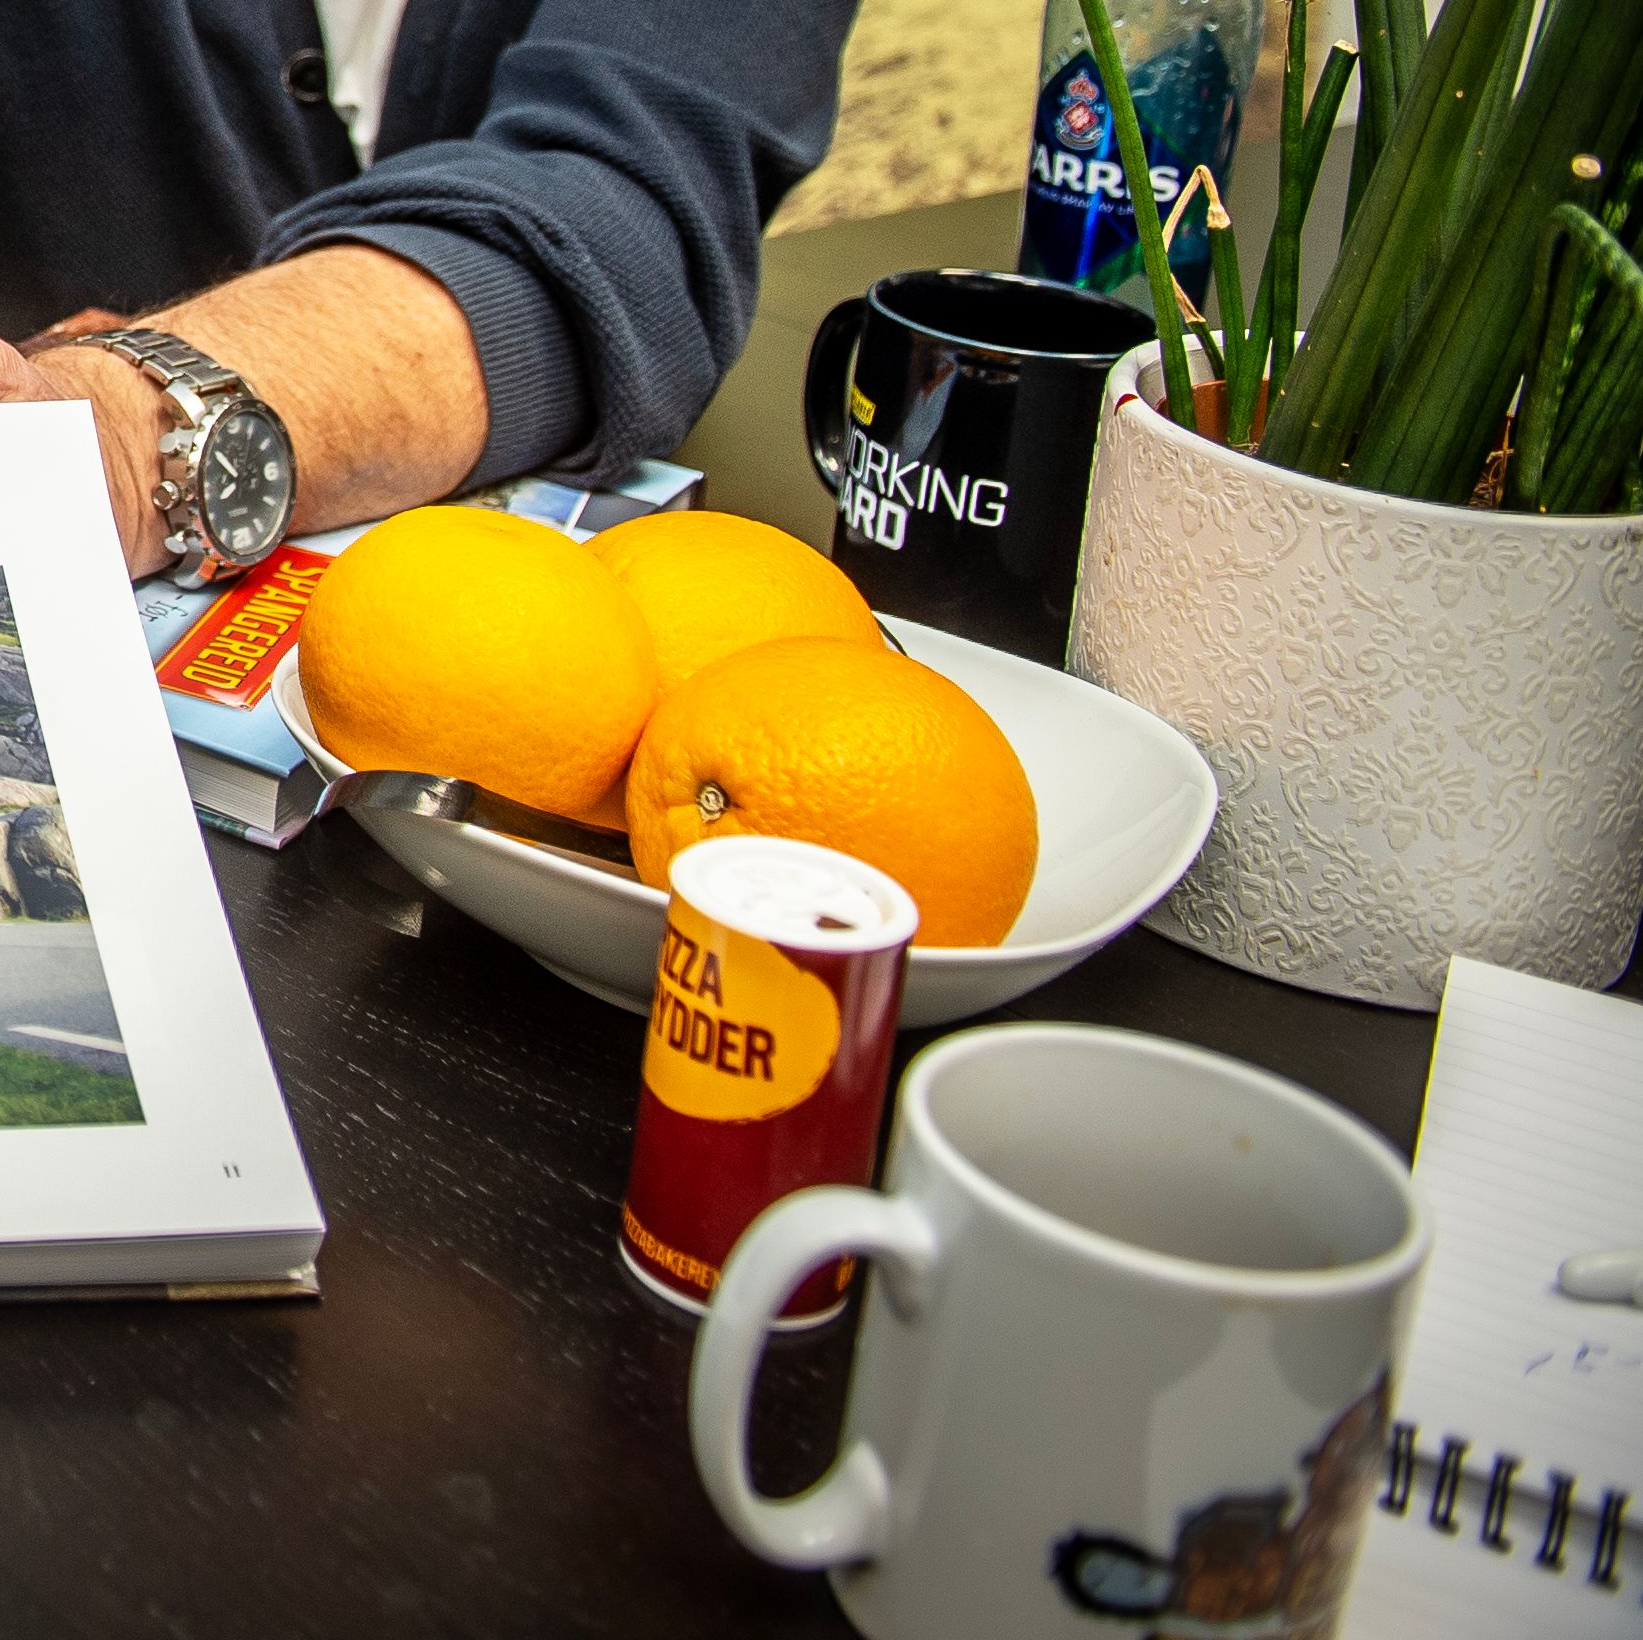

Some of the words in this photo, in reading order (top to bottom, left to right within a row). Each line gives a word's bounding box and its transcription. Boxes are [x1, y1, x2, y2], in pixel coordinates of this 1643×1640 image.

[1032, 142, 1181, 203] ARRS
[841, 474, 910, 552] ARD
[848, 424, 1010, 528] ORKING
[181, 560, 323, 691] SPANGEREID
[663, 922, 723, 1008] IZZA
[653, 978, 776, 1083] YDDER
